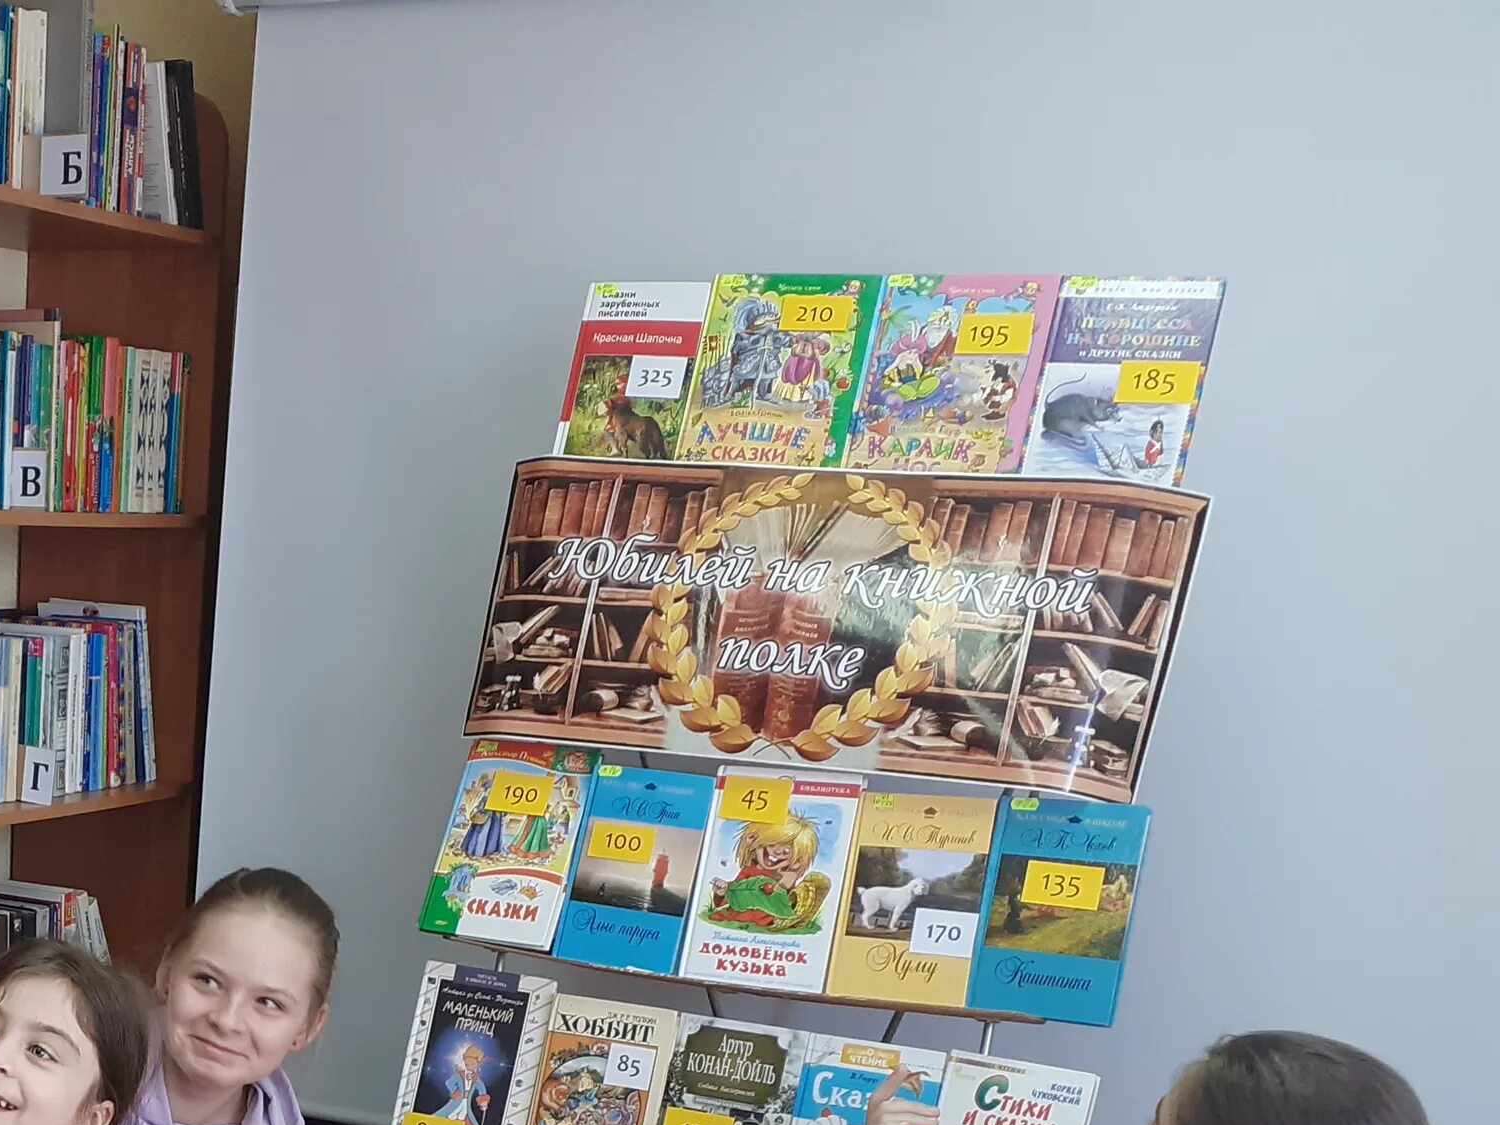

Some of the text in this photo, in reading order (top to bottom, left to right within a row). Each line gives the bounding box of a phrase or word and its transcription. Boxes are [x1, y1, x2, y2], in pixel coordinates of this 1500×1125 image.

[62, 151, 82, 185] Б
[598, 308, 647, 318] писателей
[600, 300, 660, 308] зарубежных
[796, 306, 833, 322] 210
[593, 332, 682, 344] Красная Шапочка
[969, 324, 1009, 348] 195
[1096, 333, 1201, 347] ГОРОШИНЕ
[1088, 348, 1132, 359] ДРУГИЕ
[1135, 349, 1182, 360] СКАЗКИ
[637, 369, 672, 387] 325
[1132, 369, 1175, 395] 185
[695, 421, 811, 450] ЛУЧШИЕ
[711, 446, 787, 462] СКАЗКИ
[868, 436, 976, 462] КАРЛИК
[892, 457, 942, 472] НОС
[20, 466, 40, 497] В
[548, 532, 1101, 617] Юбилей на книжной
[717, 632, 868, 693] полке
[31, 762, 48, 790] Г
[503, 784, 538, 804] 190
[741, 788, 769, 811] 45
[799, 783, 852, 794] БИБЛИОТЕКА
[604, 832, 642, 852] 100
[1042, 873, 1081, 898] 135
[466, 898, 539, 922] СКАЗКИ
[571, 906, 617, 935] Алые
[927, 924, 961, 943] 170
[698, 941, 808, 966] ДОМОВЁНОК
[866, 943, 940, 983] Муму
[715, 957, 787, 978] КУЗЬКА
[995, 956, 1092, 992] Каштанка
[442, 999, 515, 1023] МАЛЕНЬКИЙ
[454, 1018, 496, 1038] ПРИНЦ
[556, 1012, 655, 1044] ХОББИТ
[717, 1034, 754, 1056] Артур
[616, 1055, 641, 1077] 85
[686, 1050, 777, 1086] КОНАН-ДОЙЛЬ
[850, 1056, 889, 1068] ЧТЕНИЕ
[1031, 1089, 1082, 1106] ЧУКОВСКИЙ
[1051, 1082, 1083, 1097] КОРНЕЙ
